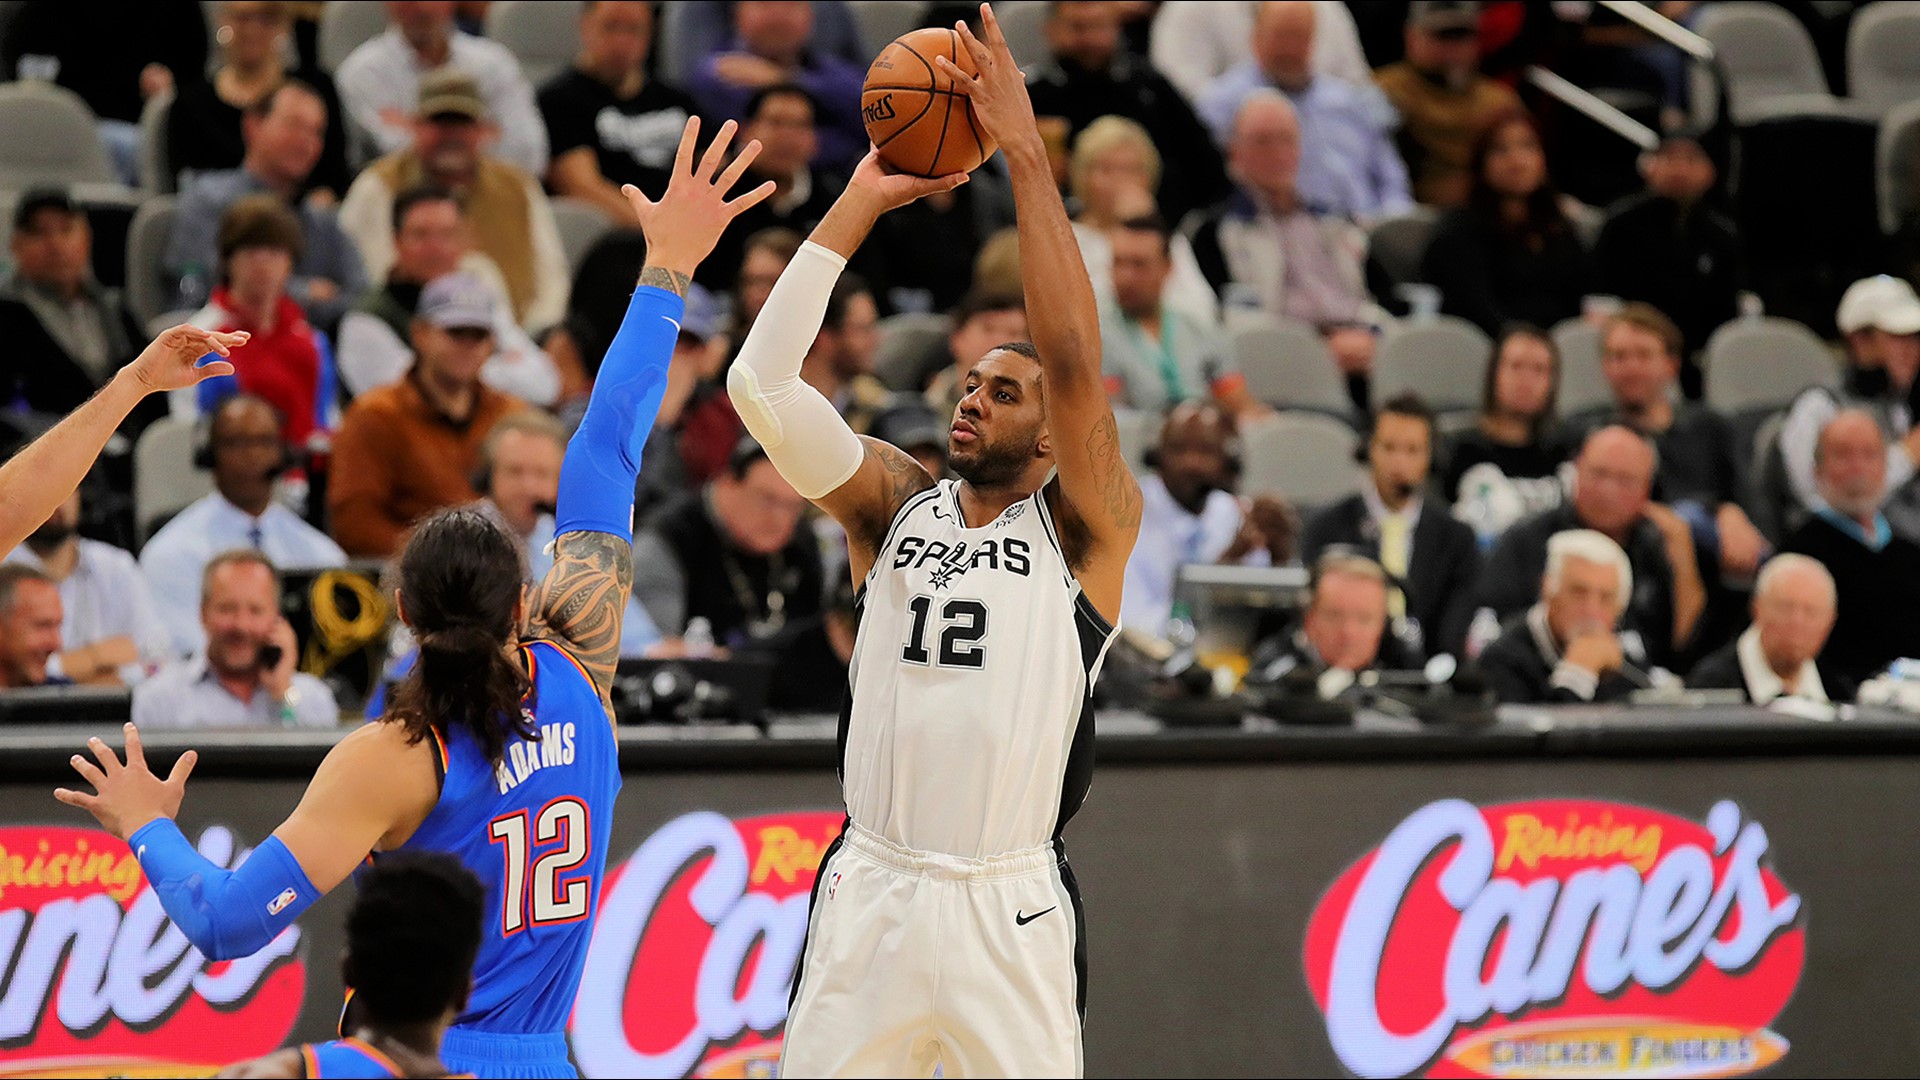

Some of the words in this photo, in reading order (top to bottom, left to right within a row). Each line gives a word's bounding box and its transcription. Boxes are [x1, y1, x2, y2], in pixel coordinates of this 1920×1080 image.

[893, 536, 1031, 579] SPURS
[901, 594, 989, 670] 12
[496, 722, 576, 795] ADAMS
[0, 838, 140, 902] aising
[488, 795, 591, 938] 12
[1496, 812, 1663, 873] Raising
[1326, 799, 1802, 1079] Cane's
